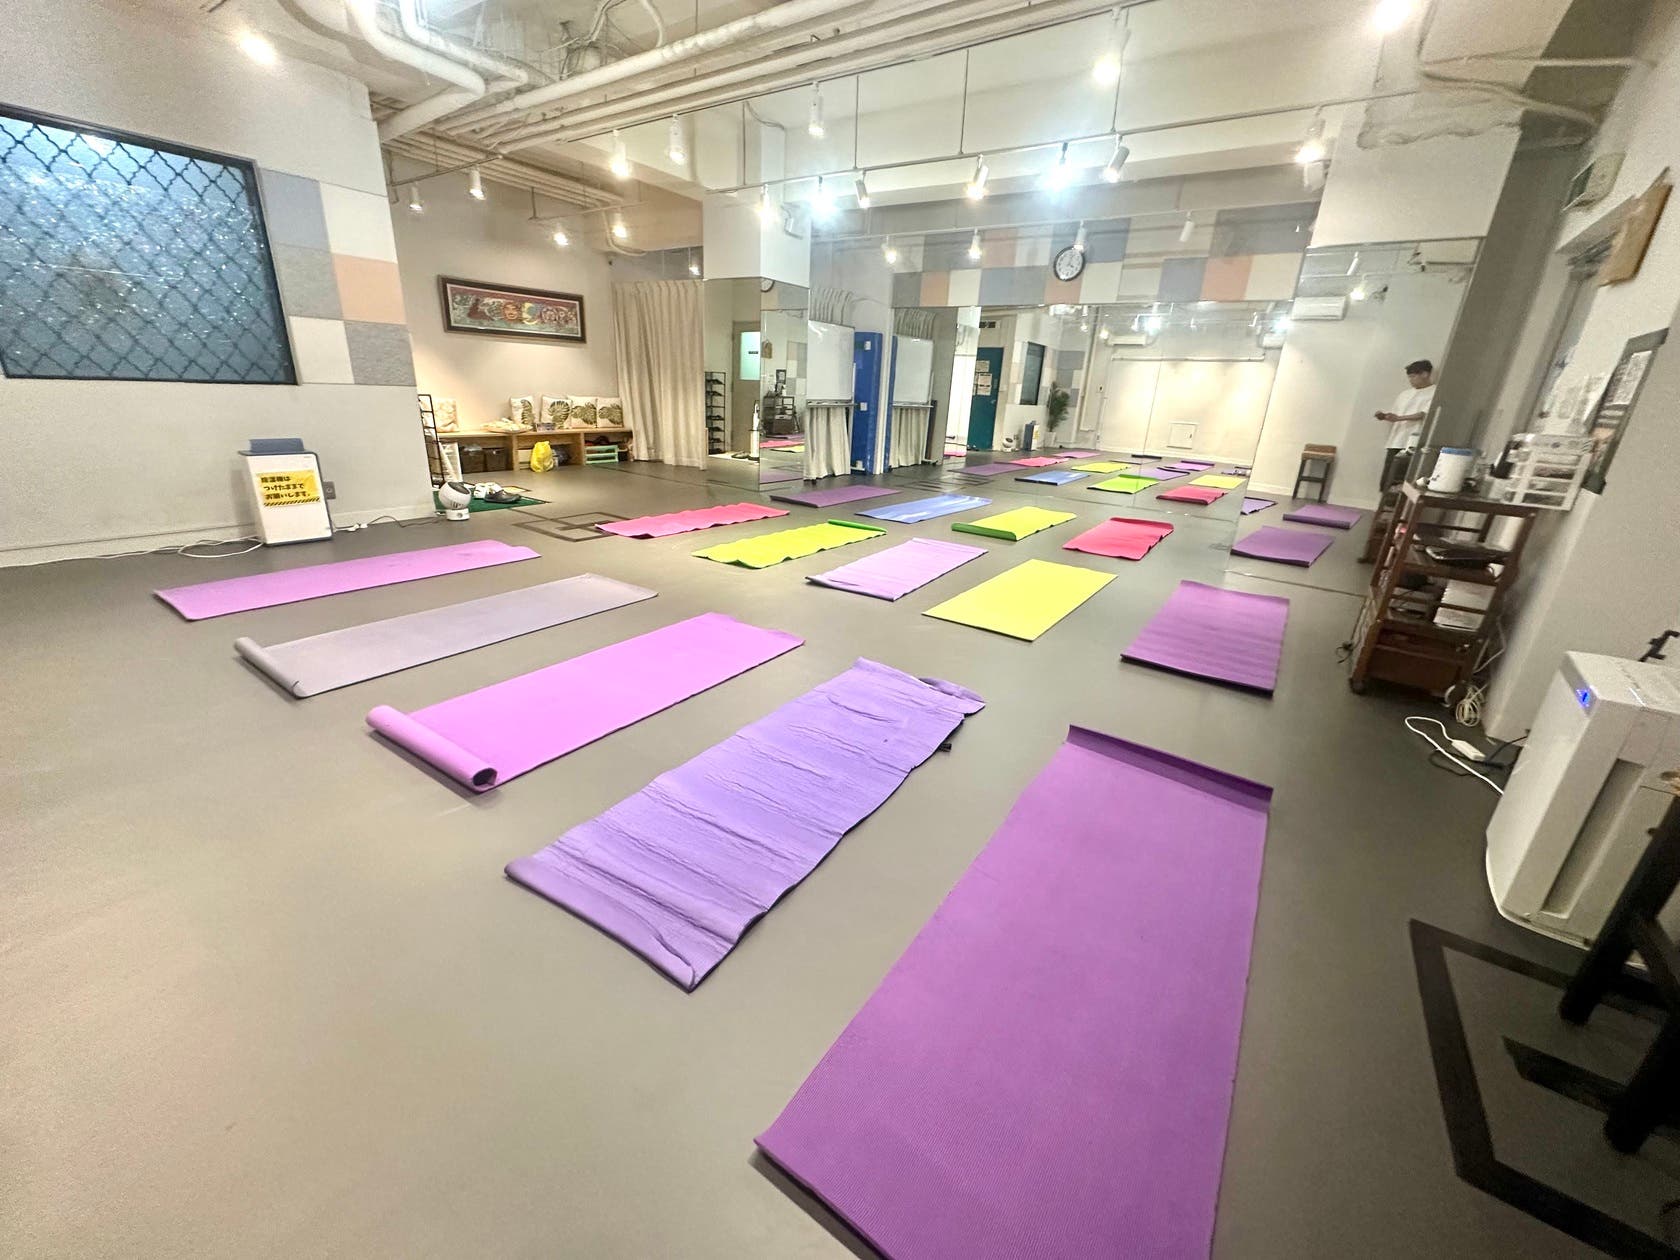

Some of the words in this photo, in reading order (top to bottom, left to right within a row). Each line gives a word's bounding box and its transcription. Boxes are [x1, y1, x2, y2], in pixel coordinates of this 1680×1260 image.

[264, 483, 304, 491] つけたままで
